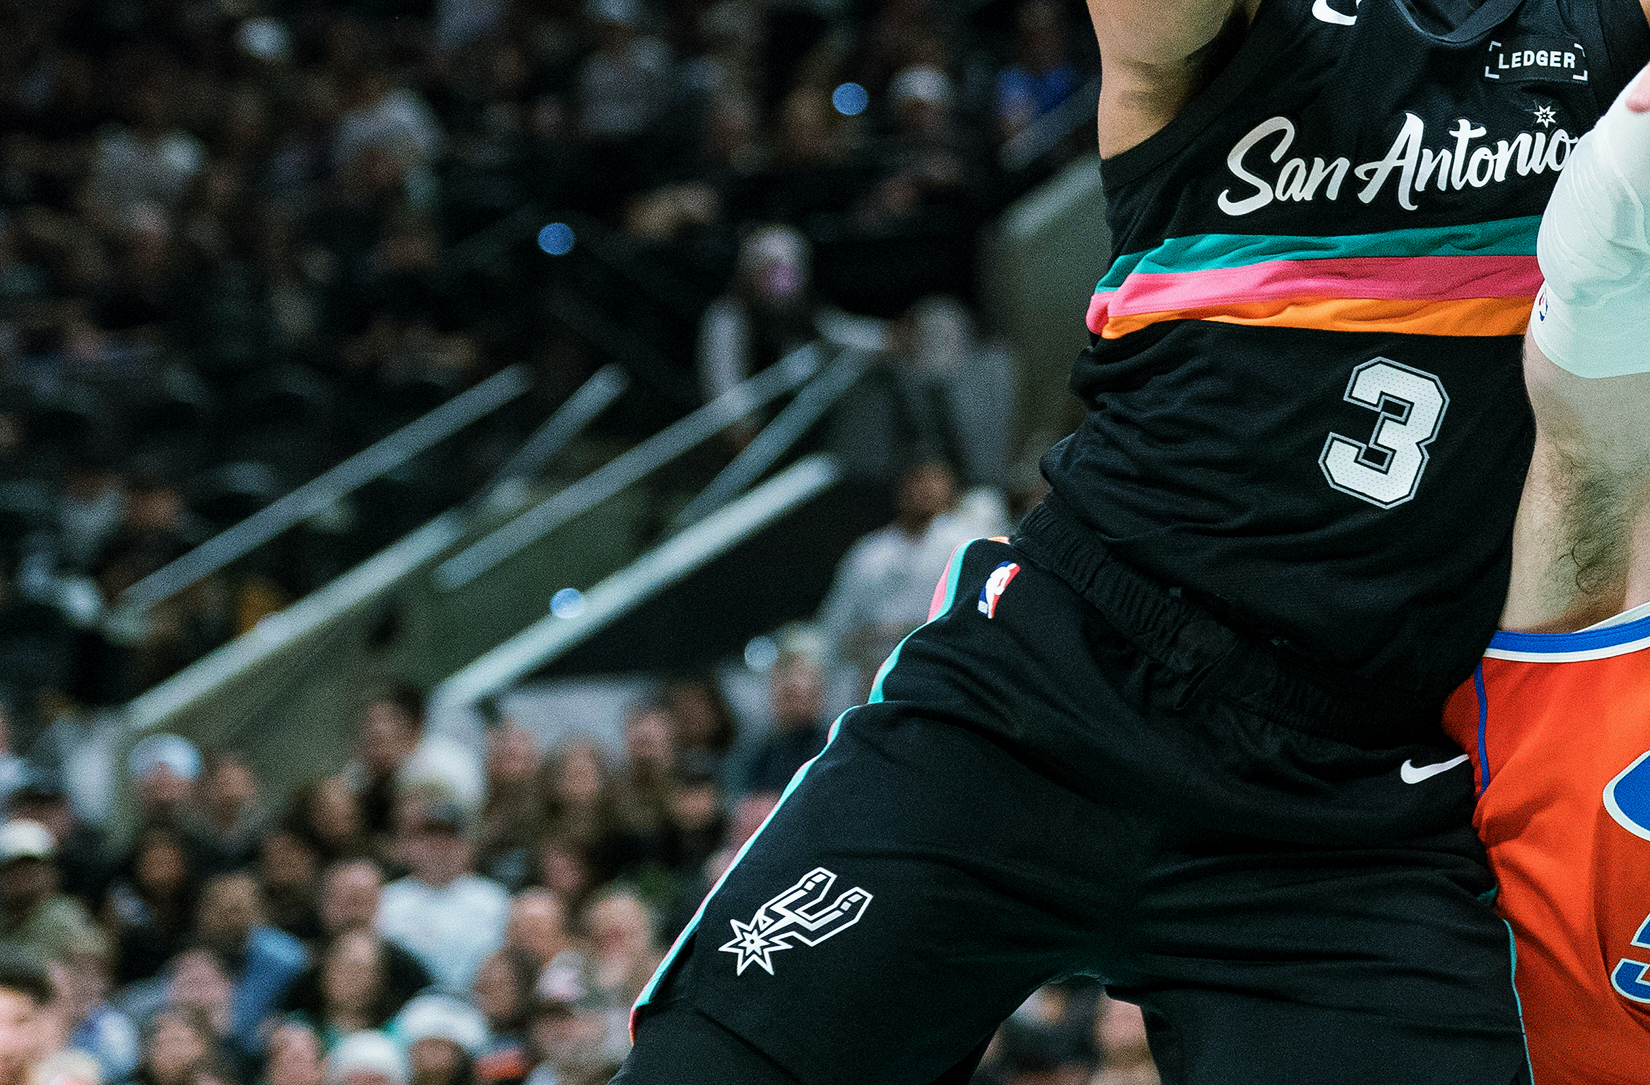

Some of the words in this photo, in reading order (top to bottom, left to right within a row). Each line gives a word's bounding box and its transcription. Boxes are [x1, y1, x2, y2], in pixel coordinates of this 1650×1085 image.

[1499, 50, 1576, 69] LEDGER
[1218, 116, 1354, 215] San
[1357, 112, 1579, 210] Antonio
[1318, 356, 1450, 510] 3
